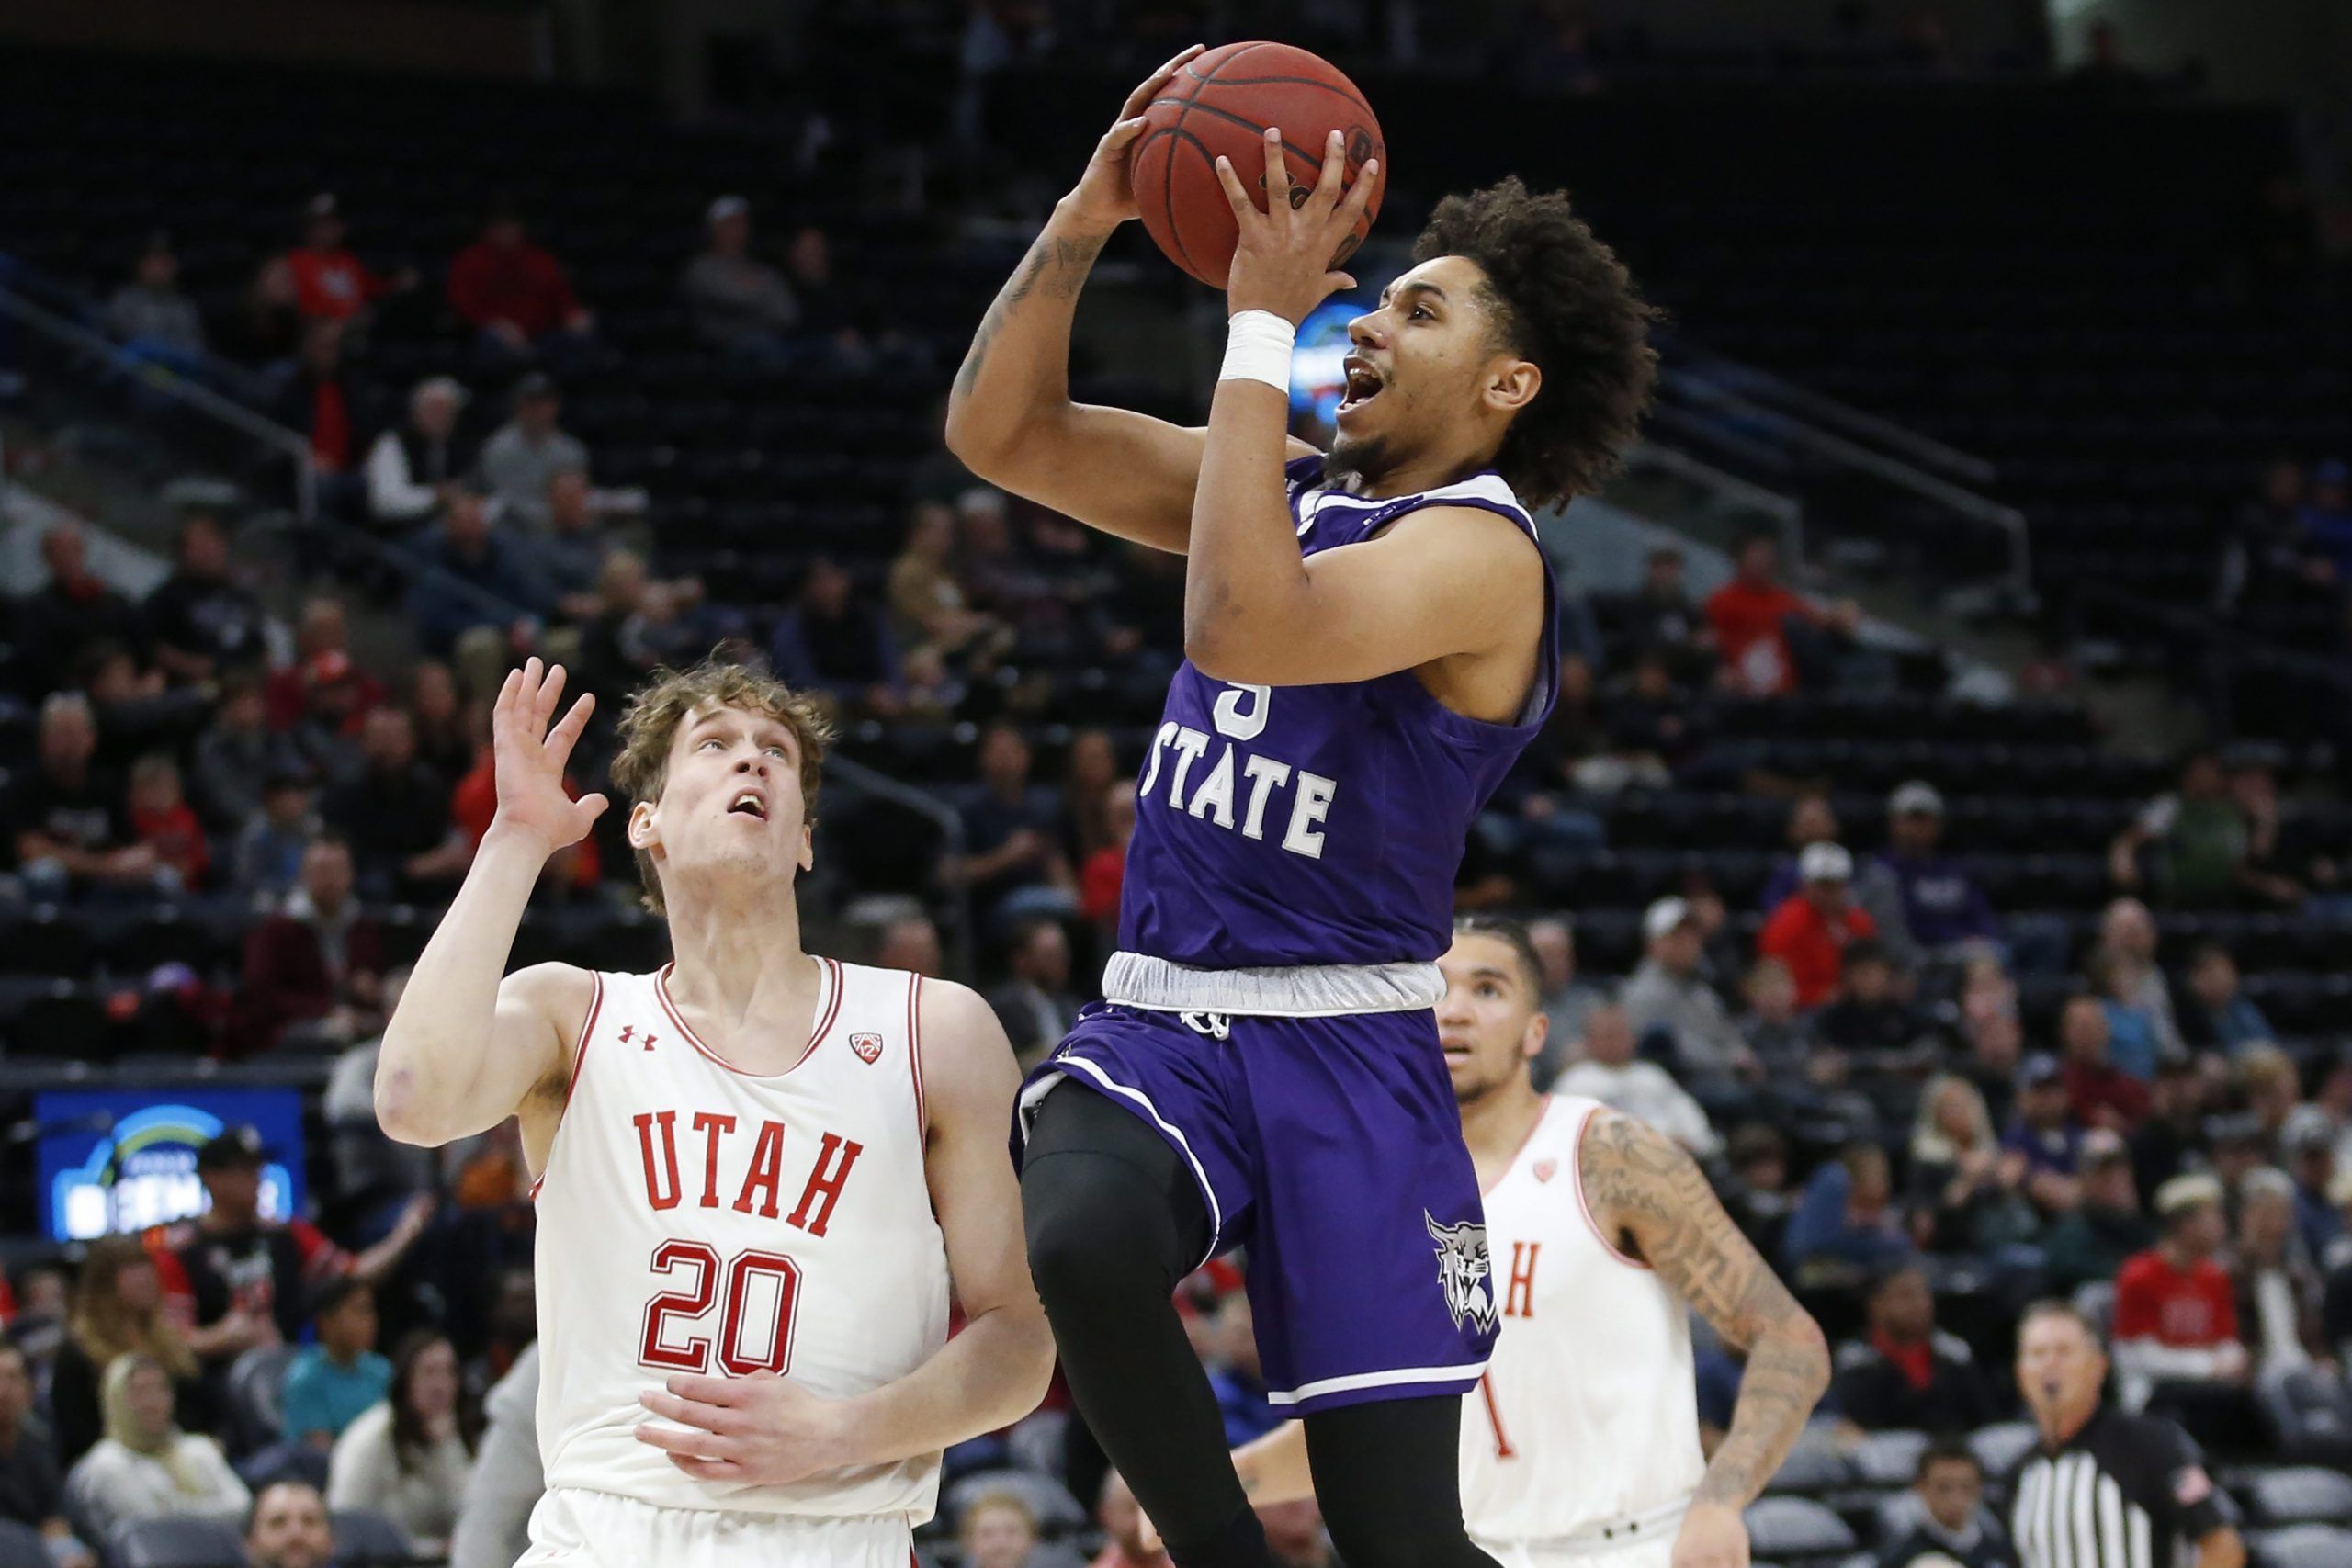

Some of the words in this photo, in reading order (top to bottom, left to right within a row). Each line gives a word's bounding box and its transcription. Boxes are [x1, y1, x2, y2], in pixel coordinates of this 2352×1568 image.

[1139, 721, 1337, 859] STATE
[633, 1110, 864, 1237] UTAH
[637, 1238, 803, 1379] 20
